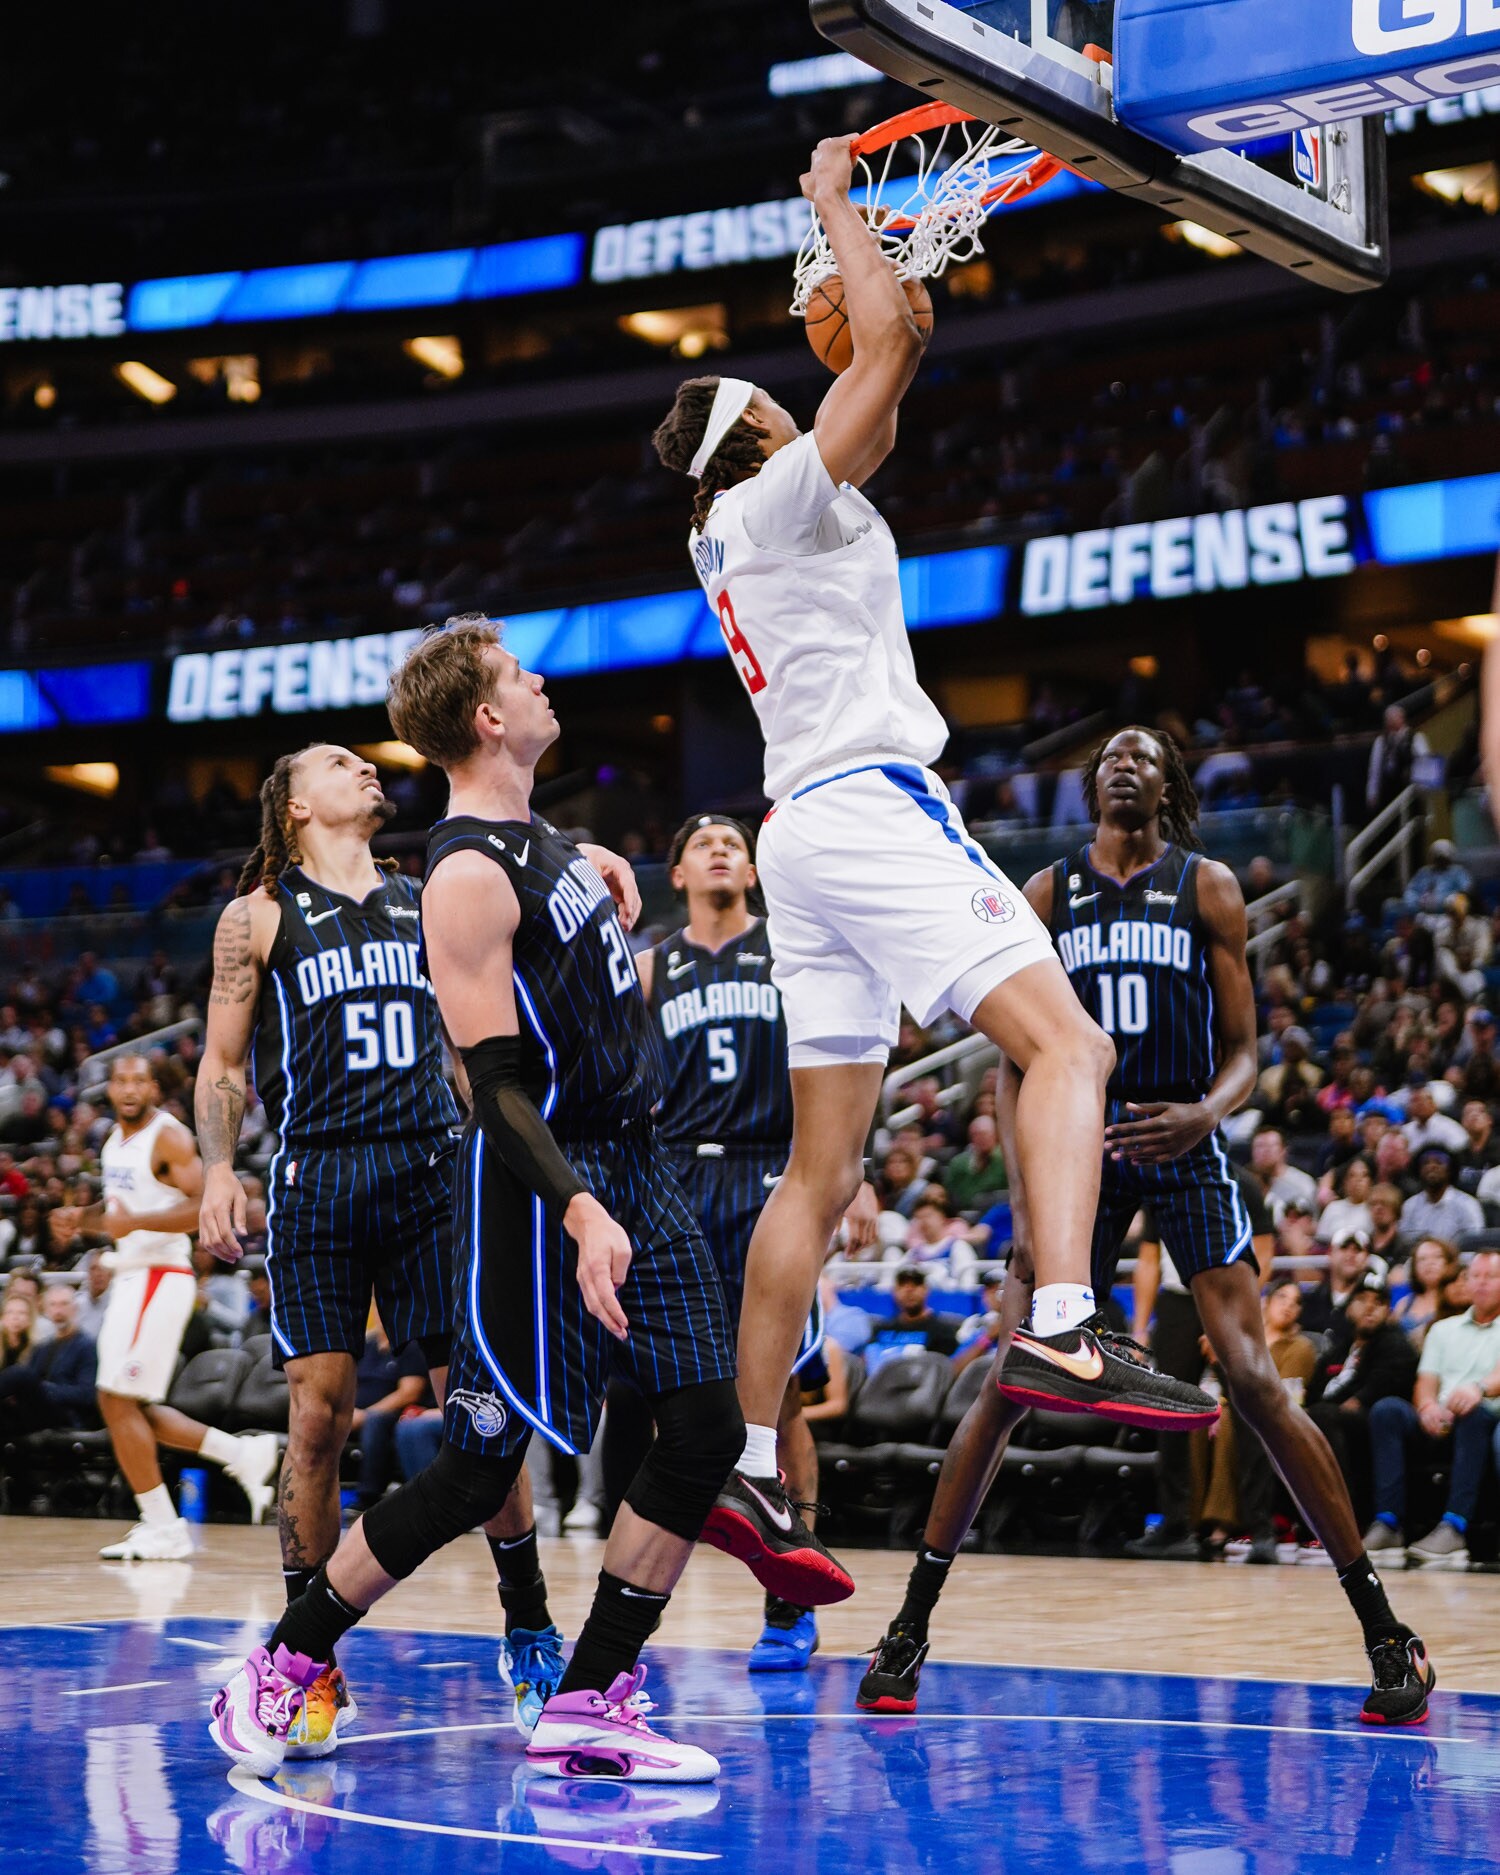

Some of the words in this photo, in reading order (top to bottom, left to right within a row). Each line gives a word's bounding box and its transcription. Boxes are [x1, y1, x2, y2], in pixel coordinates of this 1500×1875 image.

[1019, 494, 1356, 618] DEFENSE
[716, 588, 768, 695] 9
[487, 834, 506, 851] 6
[295, 892, 312, 908] 6
[1069, 873, 1082, 891] 6
[599, 912, 638, 998] 21
[1058, 920, 1192, 974] ORLANDO
[660, 981, 779, 1041] ORLANDO
[1097, 973, 1149, 1034] 10
[344, 1000, 418, 1071] 50
[706, 1027, 738, 1083] 5
